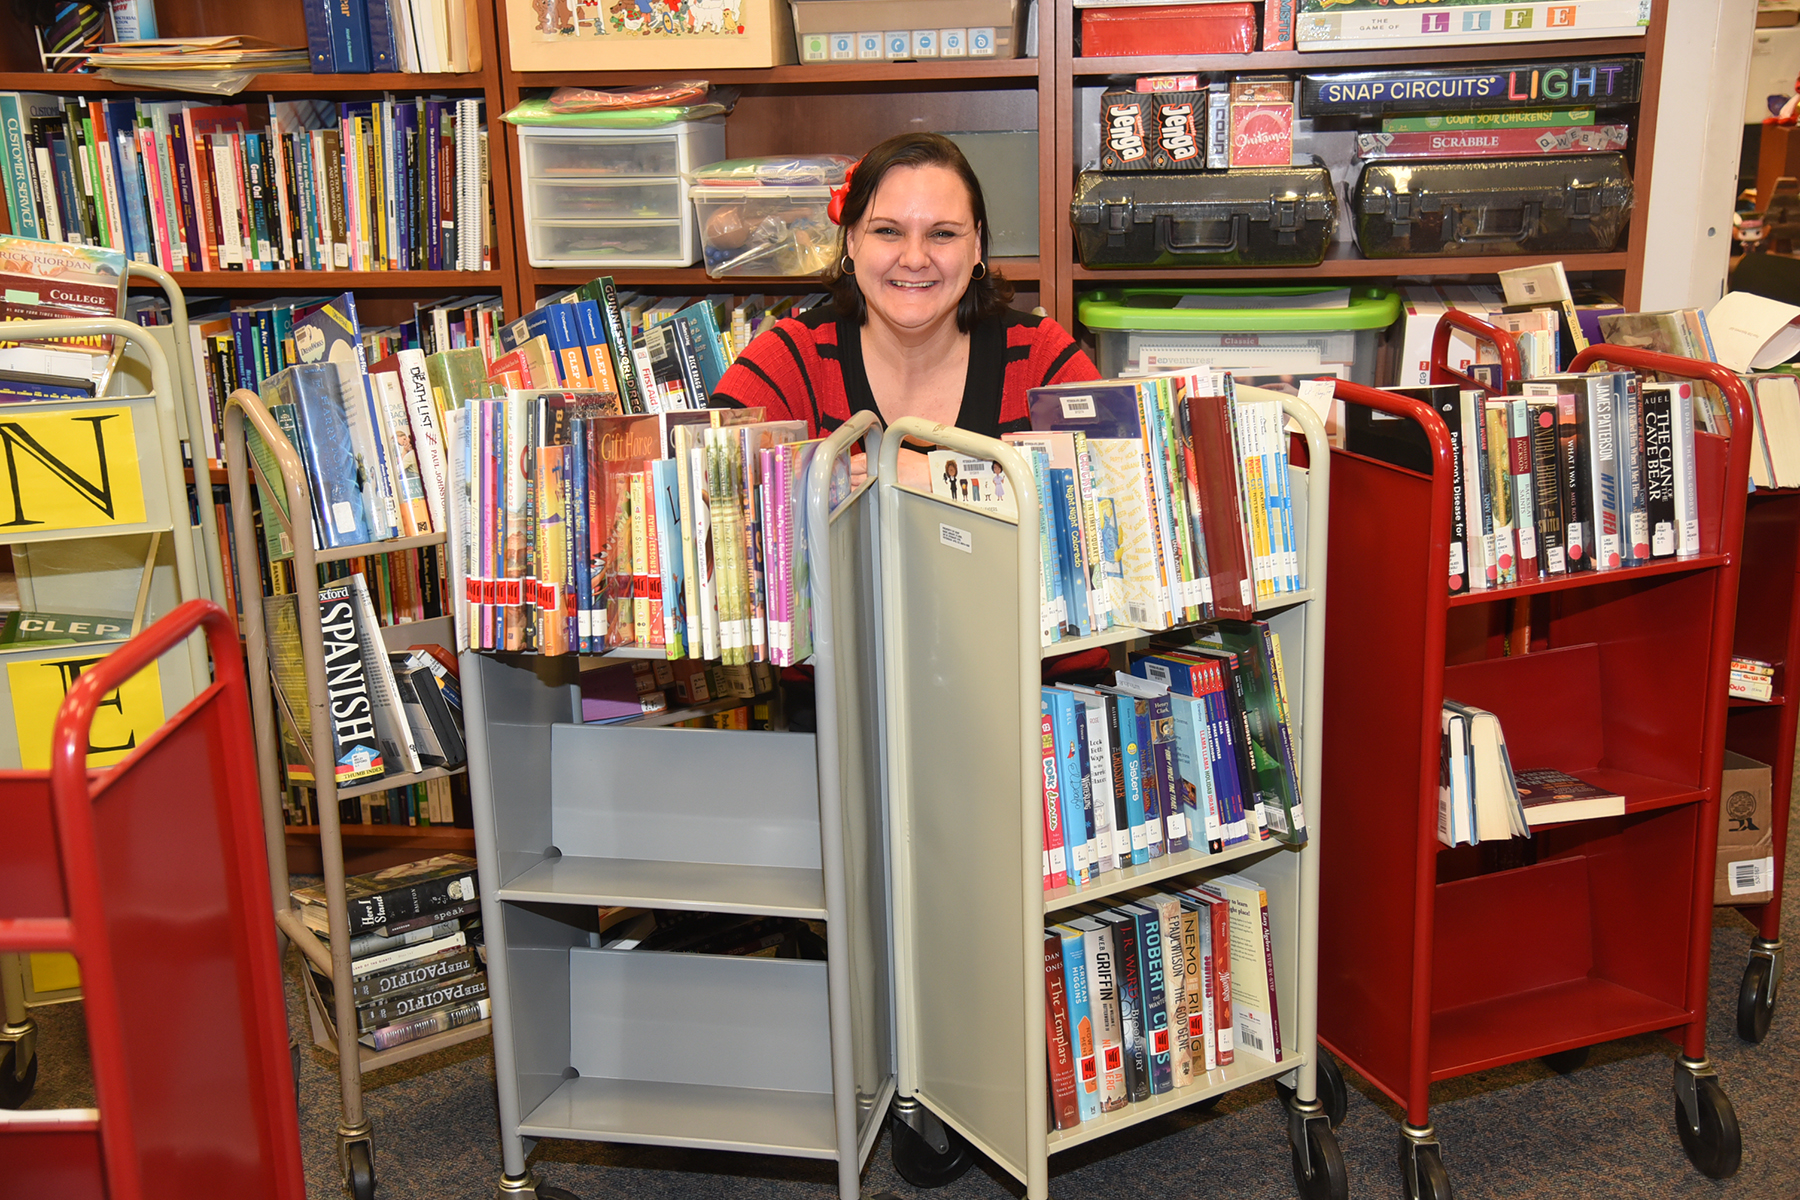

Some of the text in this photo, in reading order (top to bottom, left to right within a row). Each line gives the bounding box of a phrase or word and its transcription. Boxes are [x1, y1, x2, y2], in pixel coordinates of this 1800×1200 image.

[1152, 79, 1175, 90] UNO
[1328, 66, 1623, 102] SNAP CIRCUITS LIGHT
[1110, 105, 1145, 161] Jenga
[1162, 104, 1197, 160] Jenga
[1446, 110, 1553, 125] COUNT YOUR CHICKENS!
[1432, 136, 1499, 149] SCRABBLE
[7, 118, 34, 228] CUSTOMER SERVICE
[25, 140, 41, 202] CUSTOMER SERVICE EXCELLENCE
[40, 169, 48, 179] The
[178, 163, 187, 179] Fluent
[250, 163, 262, 199] Game On!
[165, 198, 174, 218] Library
[181, 184, 189, 202] Fantasy
[215, 150, 232, 245] DEVELOPMENT AND MANAGEMENT
[329, 180, 337, 221] CLASSIFICATION
[331, 150, 344, 237] INTRODUCTION TO CATALOGING
[43, 205, 55, 222] Manual
[167, 219, 177, 245] Handbook
[0, 252, 92, 270] RICK RIORDAN
[50, 289, 106, 305] COLLEGE
[604, 284, 626, 346] GUINNESS
[620, 346, 636, 387] WORLD
[1224, 336, 1256, 346] Classic
[1570, 319, 1579, 341] Gravett
[567, 351, 578, 379] CLEP
[594, 348, 607, 381] CLEP
[410, 366, 427, 404] DEATH
[642, 368, 658, 406] First Aid
[1644, 395, 1670, 405] AUEL
[384, 404, 403, 413] COME
[389, 410, 407, 419] BACK
[398, 418, 409, 427] ME
[417, 405, 433, 431] LIST
[1136, 391, 1146, 426] BROOKS
[1478, 397, 1486, 429] LISTENING
[1595, 384, 1613, 462] JAMES PATTERSON
[430, 449, 439, 471] PAUL
[601, 431, 653, 463] Gift Horse
[1450, 431, 1461, 485] Parkinson's
[1567, 439, 1575, 464] WHAT
[1645, 412, 1662, 502] CAVE BEAR
[1657, 408, 1673, 487] THE CLAN
[0, 414, 120, 527] N
[1537, 461, 1558, 506] BROWN
[1079, 453, 1092, 500] CRICKET
[1091, 533, 1099, 558] SQUARE
[1453, 486, 1462, 522] Disease
[1600, 472, 1616, 511] NYPD
[1145, 452, 1165, 567] POLAR OPPOSITES
[1602, 510, 1617, 535] RED
[647, 514, 657, 568] FLYING LESSONS
[1455, 523, 1463, 537] for
[1071, 531, 1081, 568] Colorado
[319, 589, 349, 602] xford
[19, 619, 121, 636] CLEP
[321, 601, 375, 746] SPANISH
[1154, 701, 1169, 709] Henry
[1156, 706, 1170, 715] Clark
[1199, 729, 1207, 750] LLAMA
[343, 766, 383, 779] THUMB INDEX
[1249, 750, 1257, 770] SPACE
[1044, 757, 1059, 832] DORK diaries
[1129, 759, 1139, 802] Sisters
[375, 895, 387, 924] Stand
[433, 906, 465, 922] speak
[1045, 951, 1060, 962] DAN
[1145, 920, 1165, 992] ROBERT
[1168, 922, 1184, 978] PAUL WILSON
[1184, 919, 1198, 976] NEMO
[1263, 928, 1271, 953] Algebra
[379, 959, 471, 992] THE PACIFIC
[1045, 962, 1064, 973] ONES
[1096, 953, 1114, 1001] GRIFFIN
[1119, 926, 1139, 999] J. R. WARD
[1203, 955, 1214, 999] SURVIVORS
[396, 982, 487, 1015] THE PACIFIC
[1050, 976, 1061, 1006] The
[1071, 966, 1082, 1005] HIGGINS
[1079, 964, 1088, 1003] KRISTAN
[1174, 985, 1190, 1052] THE GOD GENE
[1053, 1008, 1069, 1065] Templars
[1130, 1008, 1144, 1072] BLOOD FURY
